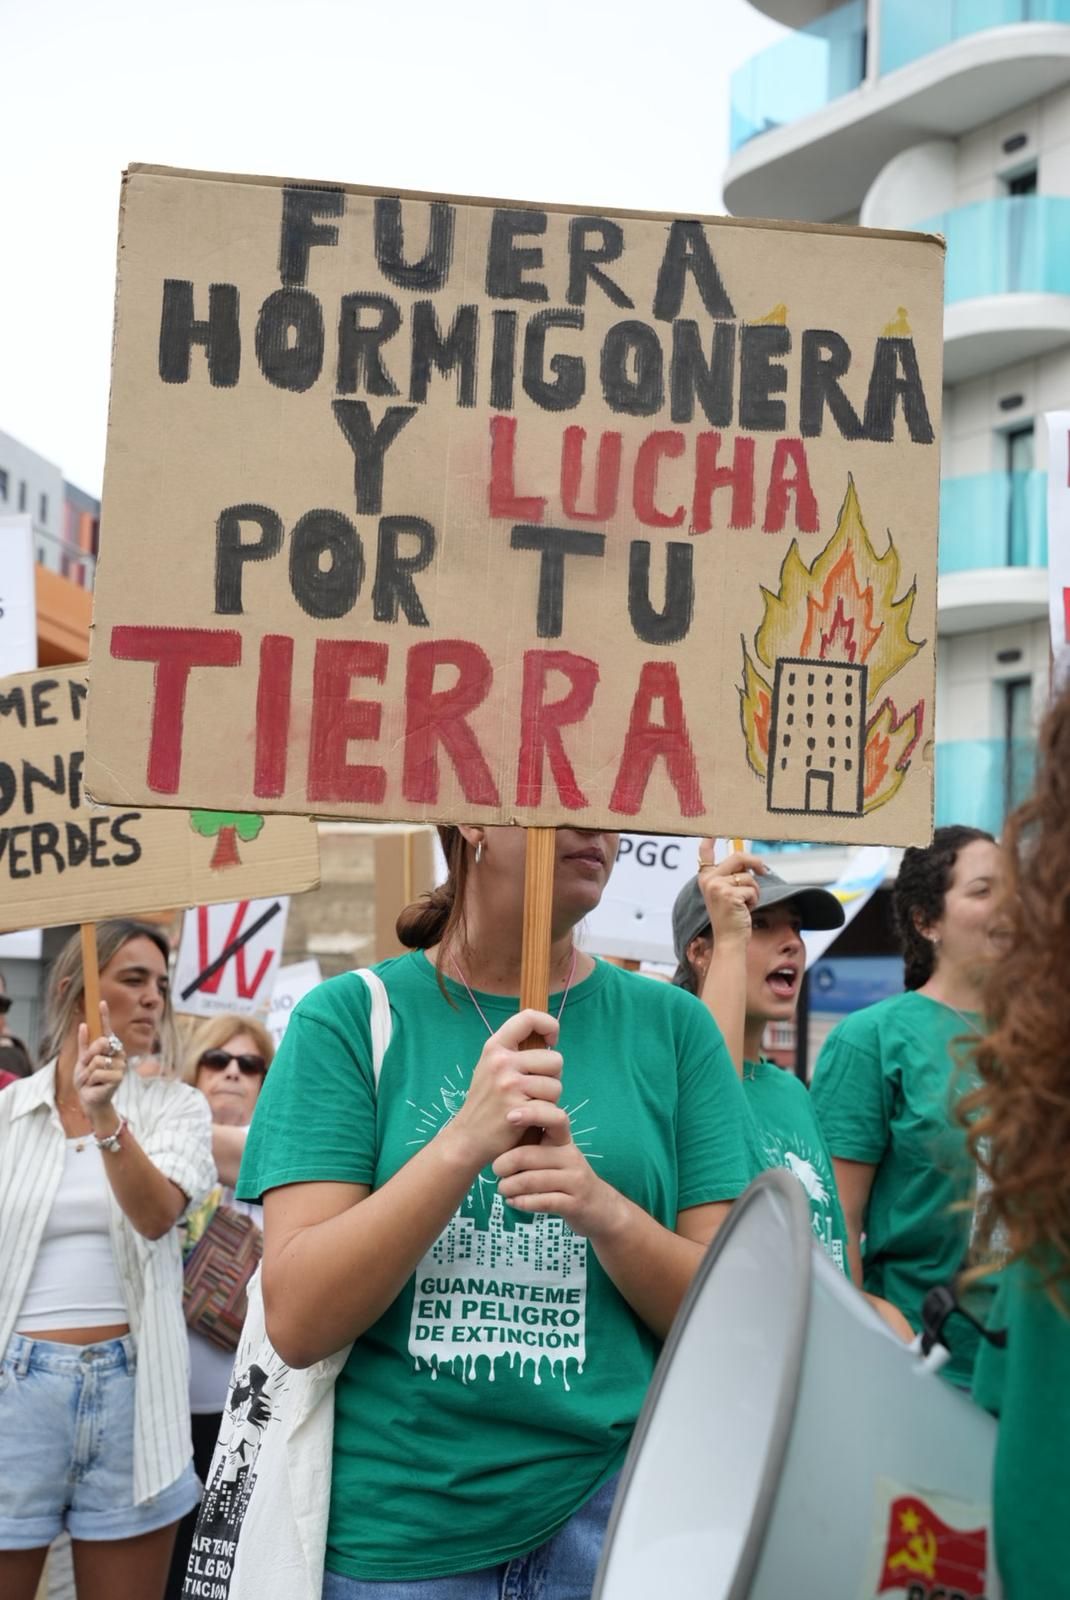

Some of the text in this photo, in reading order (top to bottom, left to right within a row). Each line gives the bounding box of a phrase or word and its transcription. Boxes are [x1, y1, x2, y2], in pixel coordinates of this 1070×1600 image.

[279, 183, 736, 323] FUERA
[158, 279, 935, 444] HORMIGONERA
[332, 399, 820, 535] Y LUCHA
[214, 503, 694, 645] POR TU
[110, 626, 706, 817] TIERRA
[415, 1325, 579, 1348] DE EXTINCIÓN
[417, 1300, 580, 1327] EN PELIGRO
[420, 1278, 581, 1304] GUANARTEME
